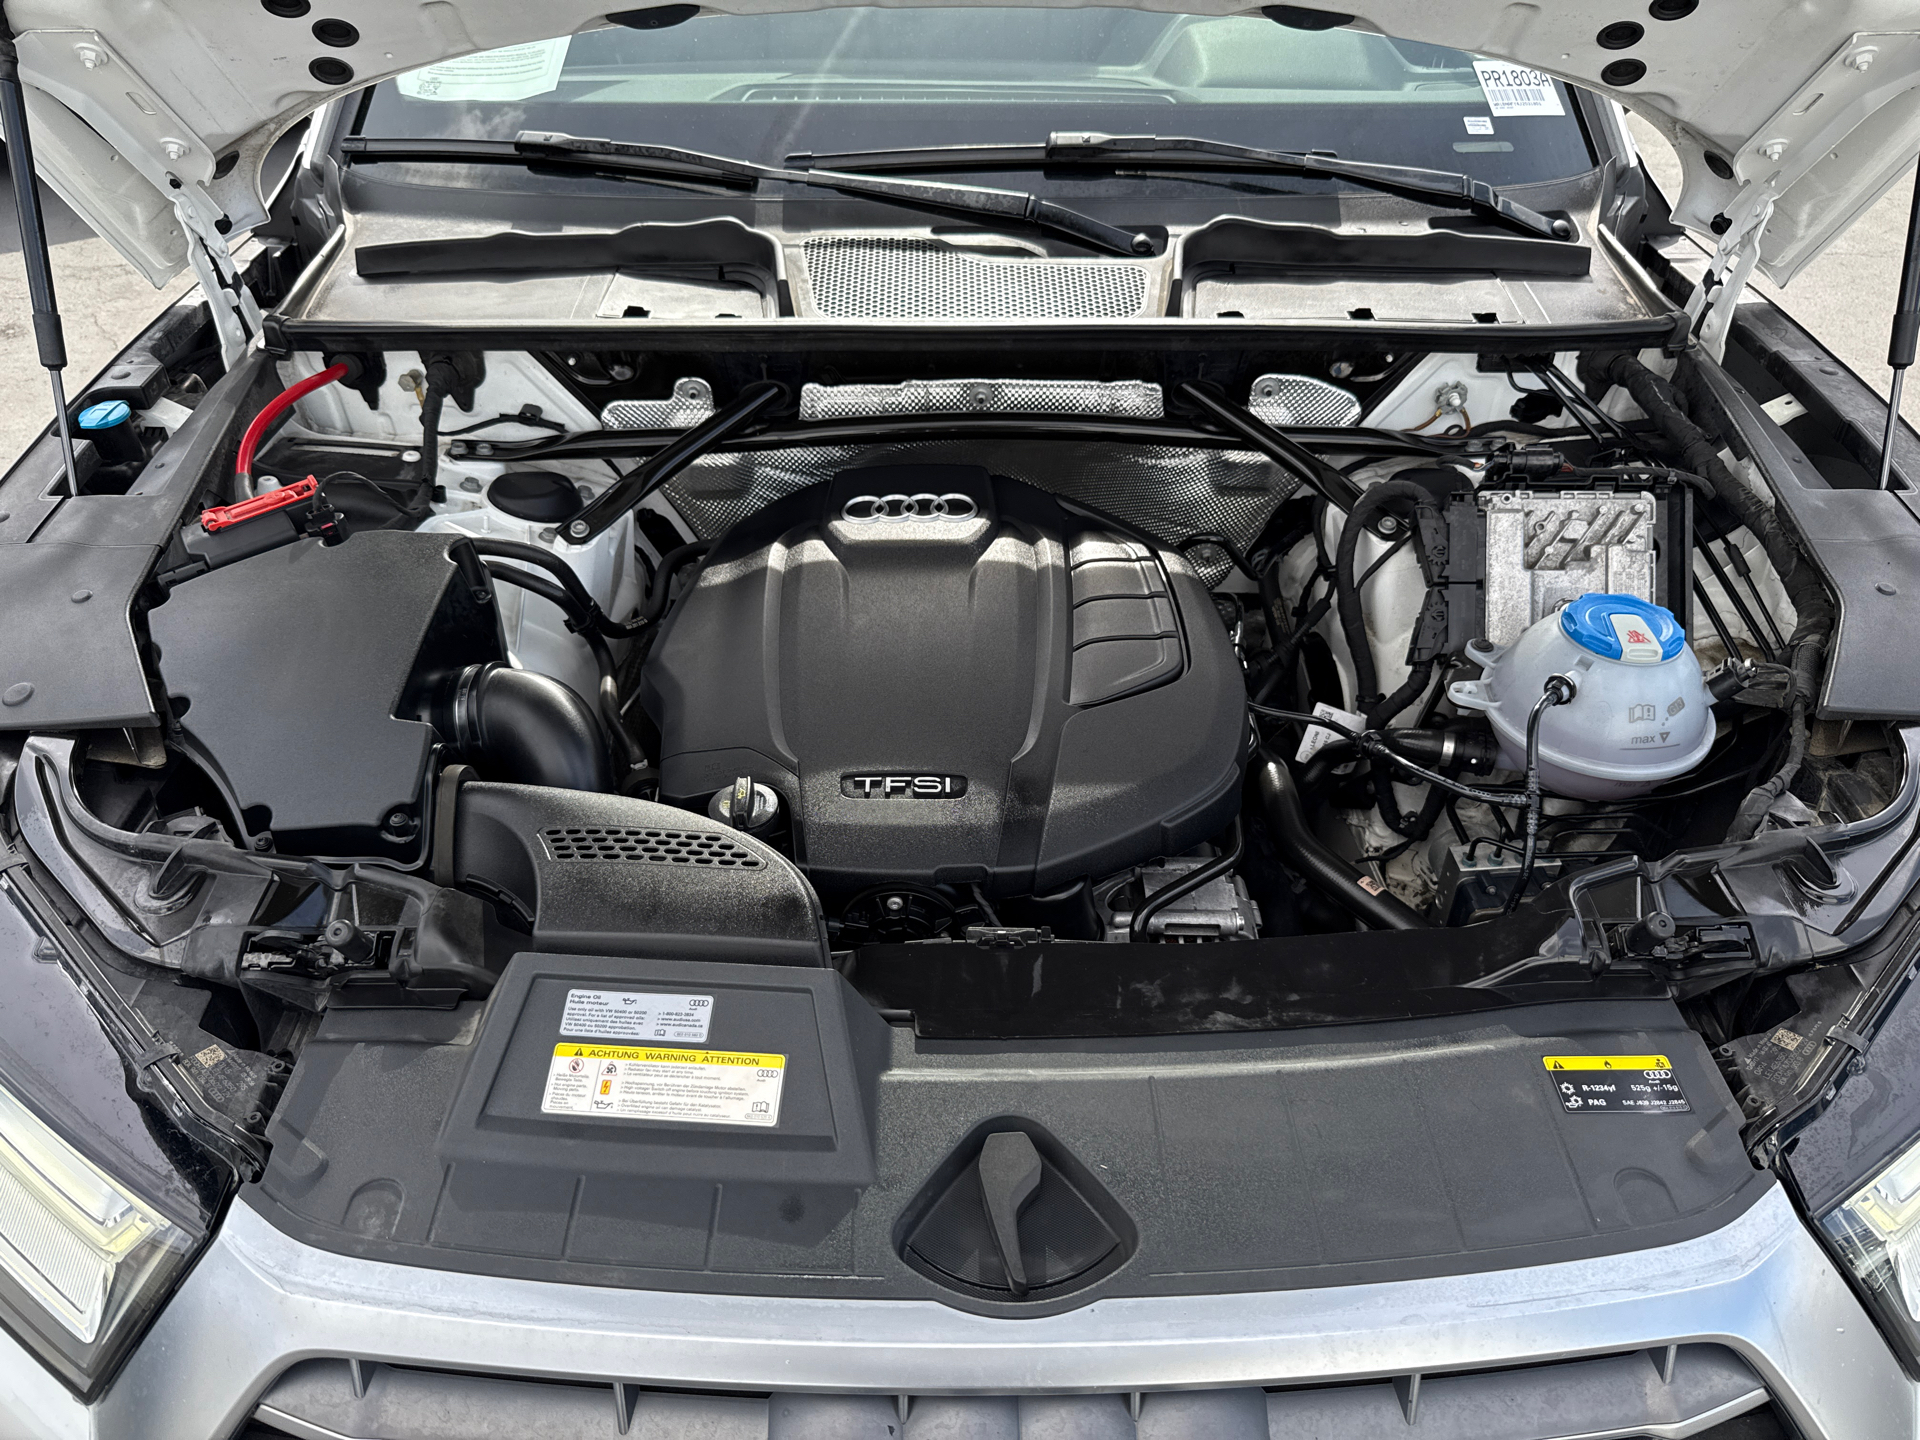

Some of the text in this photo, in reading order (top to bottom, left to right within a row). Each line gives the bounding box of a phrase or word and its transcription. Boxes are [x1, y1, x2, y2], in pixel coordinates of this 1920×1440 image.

[1480, 70, 1551, 88] PR1803A
[1631, 734, 1656, 744] max
[855, 777, 950, 792] TFSI
[588, 1050, 760, 1065] ACHTUNG WARNING ATTENTION
